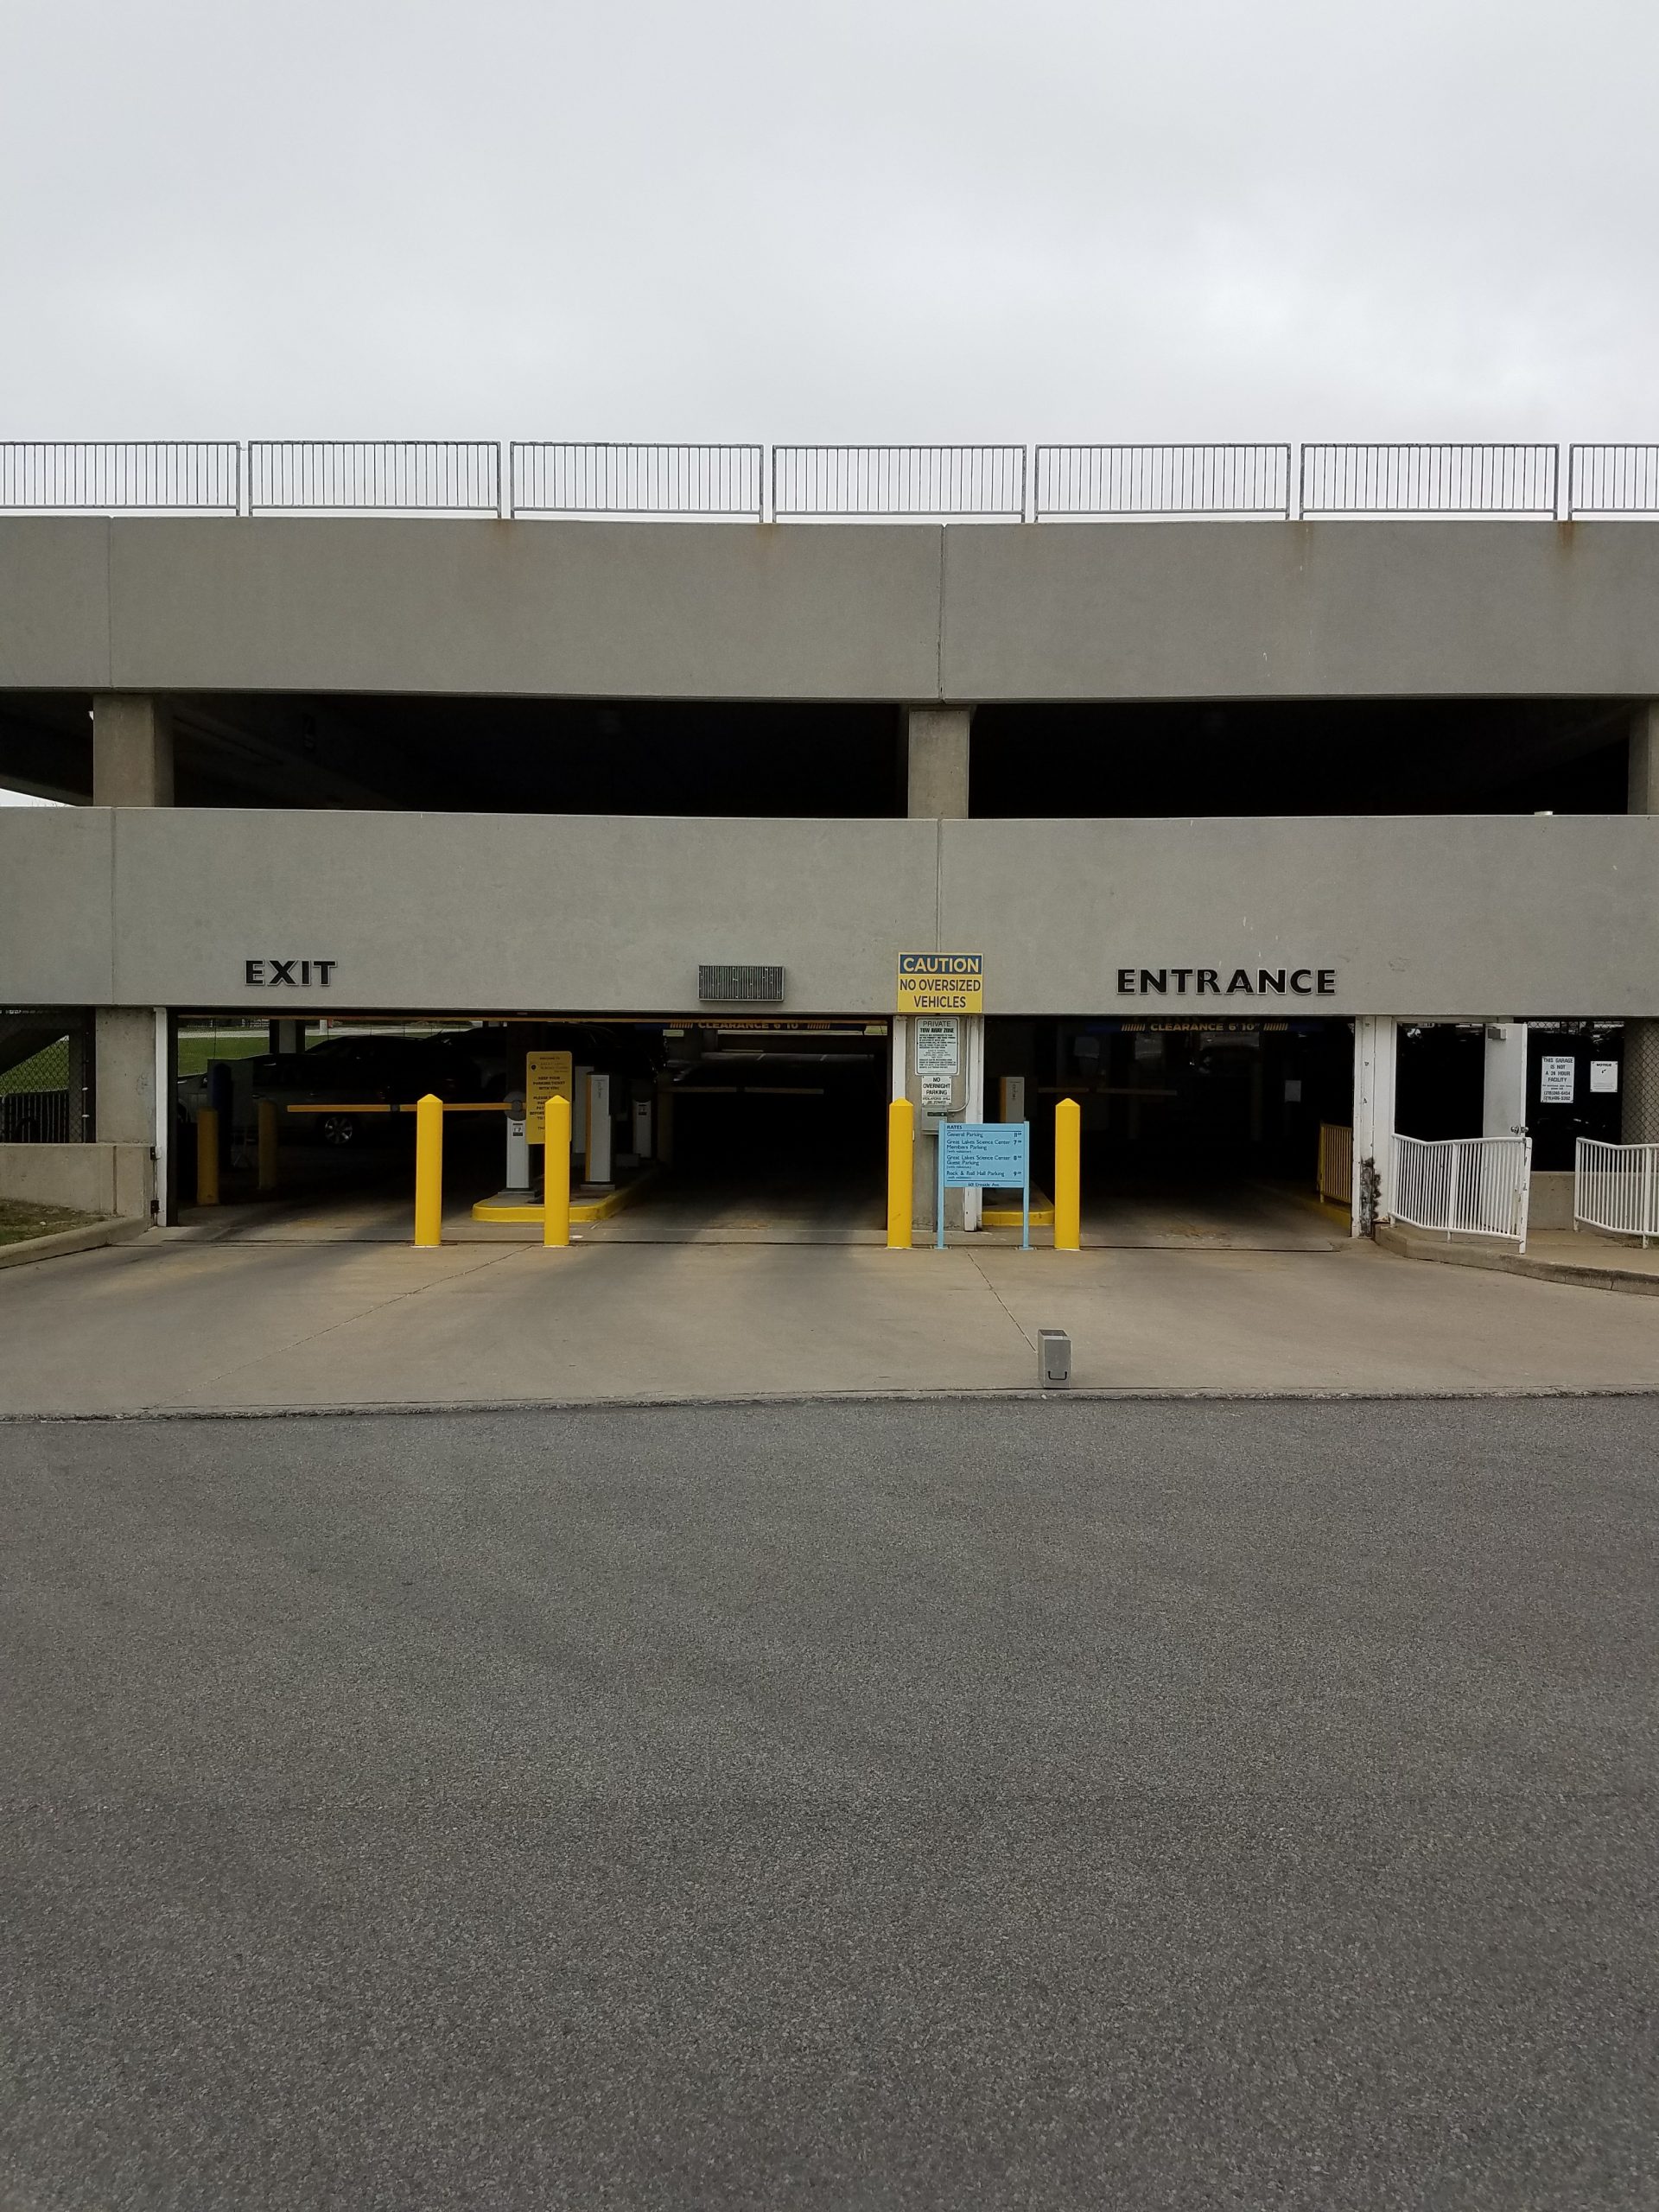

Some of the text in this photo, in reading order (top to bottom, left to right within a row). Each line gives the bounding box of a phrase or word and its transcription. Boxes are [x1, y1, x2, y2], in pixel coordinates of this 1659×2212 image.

[903, 957, 979, 973] CAUTION
[245, 960, 336, 986] EXIT
[899, 978, 981, 992] NO OVERSIZED
[1116, 969, 1337, 994] ENTRANCE
[913, 995, 966, 1008] VEHICLES
[1150, 1023, 1224, 1031] CLEARANCE
